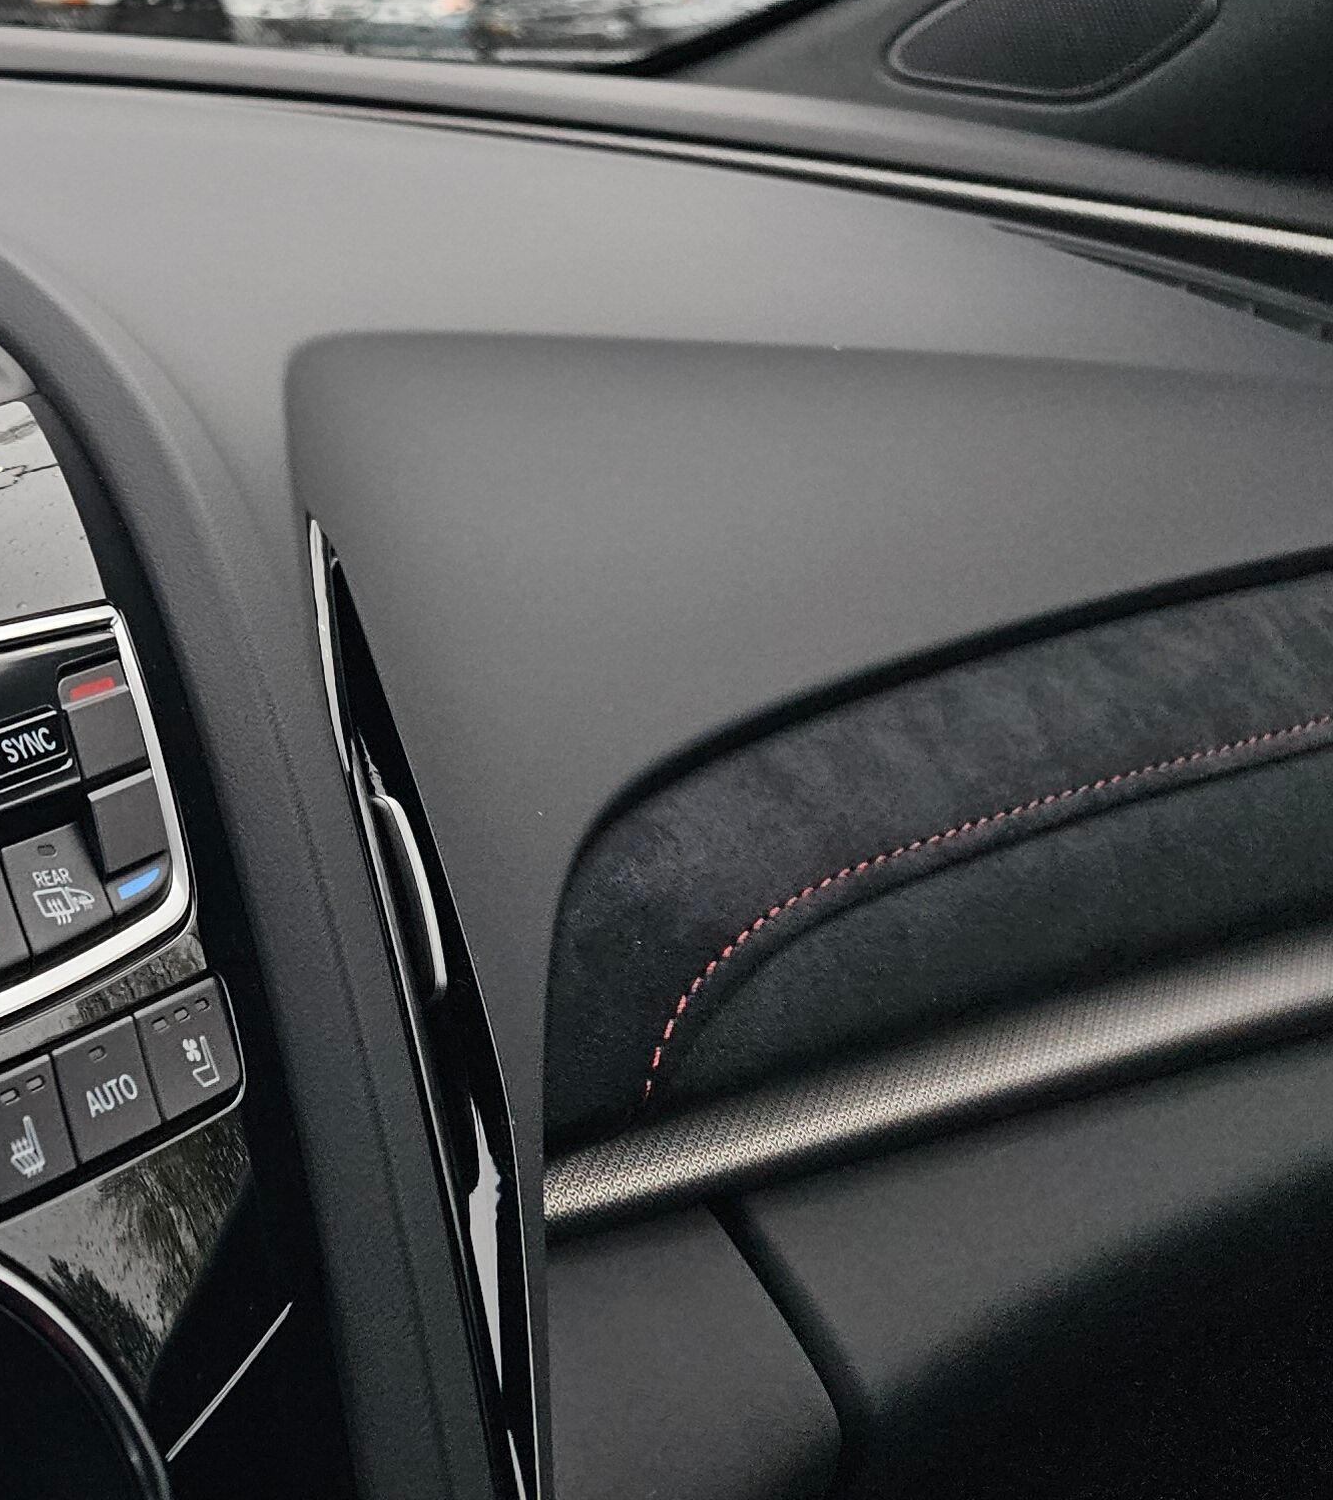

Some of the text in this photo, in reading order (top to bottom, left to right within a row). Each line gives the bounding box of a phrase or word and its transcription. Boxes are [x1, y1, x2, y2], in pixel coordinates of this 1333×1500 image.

[0, 727, 56, 765] SYNC
[33, 867, 73, 887] REAR
[85, 1074, 139, 1117] AUTO
